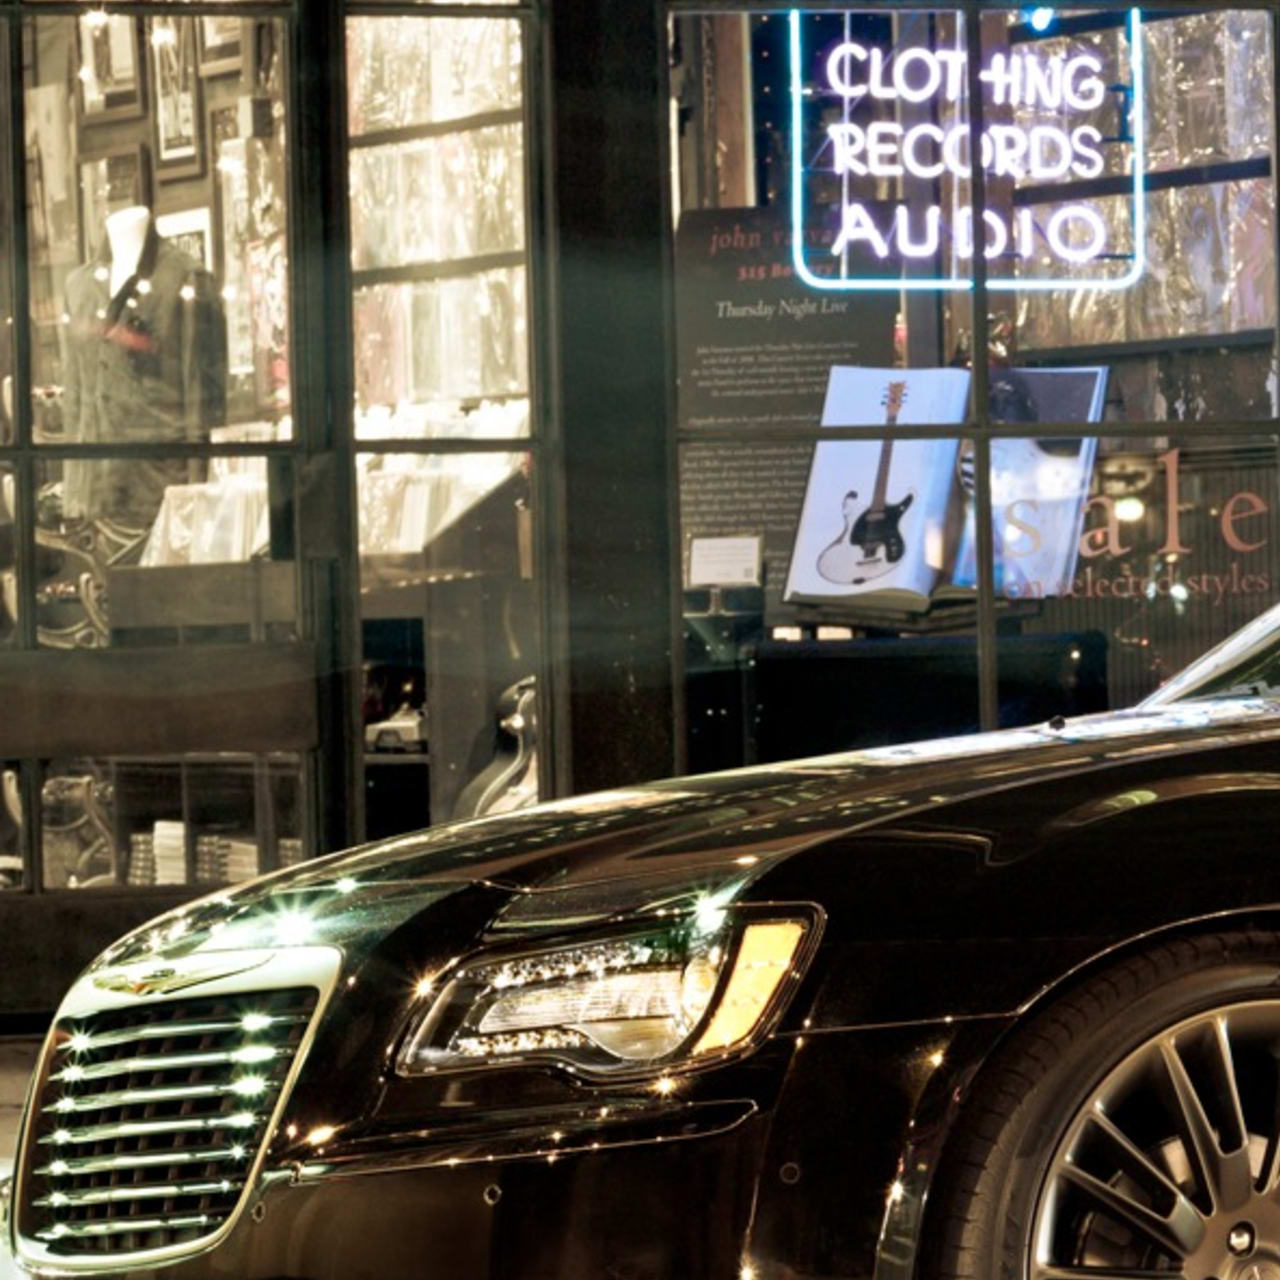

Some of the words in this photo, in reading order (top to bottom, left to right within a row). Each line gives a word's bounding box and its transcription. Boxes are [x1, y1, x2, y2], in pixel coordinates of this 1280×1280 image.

[825, 41, 1106, 111] CLOTHING
[827, 121, 1105, 180] RECORDS
[831, 203, 1107, 263] AUDIO
[716, 298, 775, 320] Thursday
[778, 298, 818, 321] Night
[820, 297, 849, 314] Live
[1004, 447, 1269, 560] sale
[1186, 562, 1270, 607] styles
